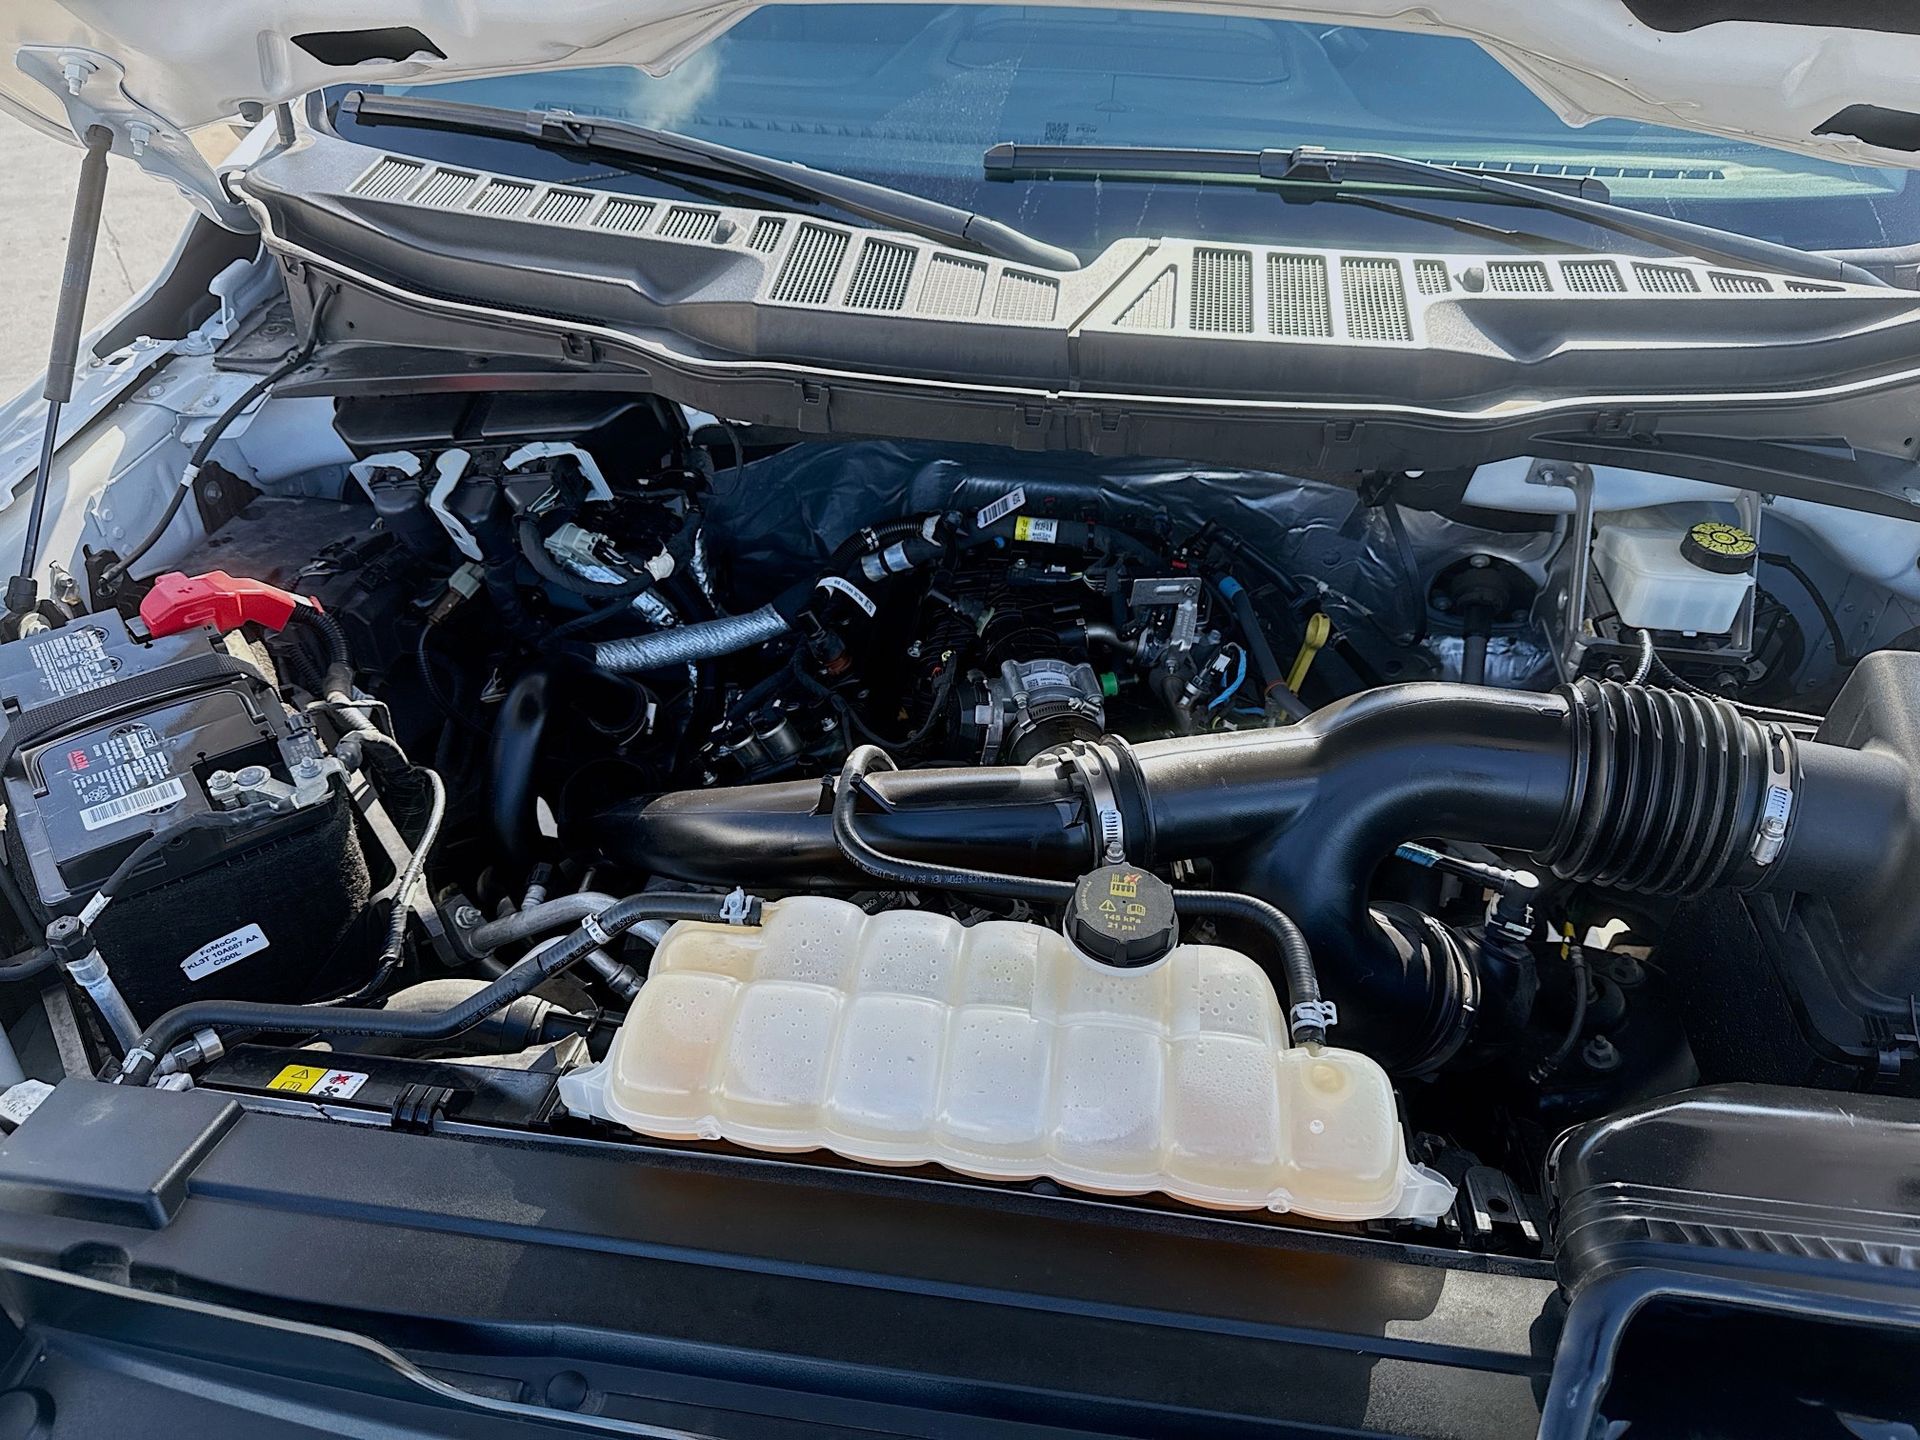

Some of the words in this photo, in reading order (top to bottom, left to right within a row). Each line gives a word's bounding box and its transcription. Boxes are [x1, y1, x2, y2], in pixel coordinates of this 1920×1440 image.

[1104, 913, 1121, 921] 145
[1123, 916, 1141, 924] kPa
[1107, 921, 1119, 929] 21
[187, 956, 210, 970] KL3T
[245, 934, 259, 944] AA
[200, 936, 238, 956] FoMoCo
